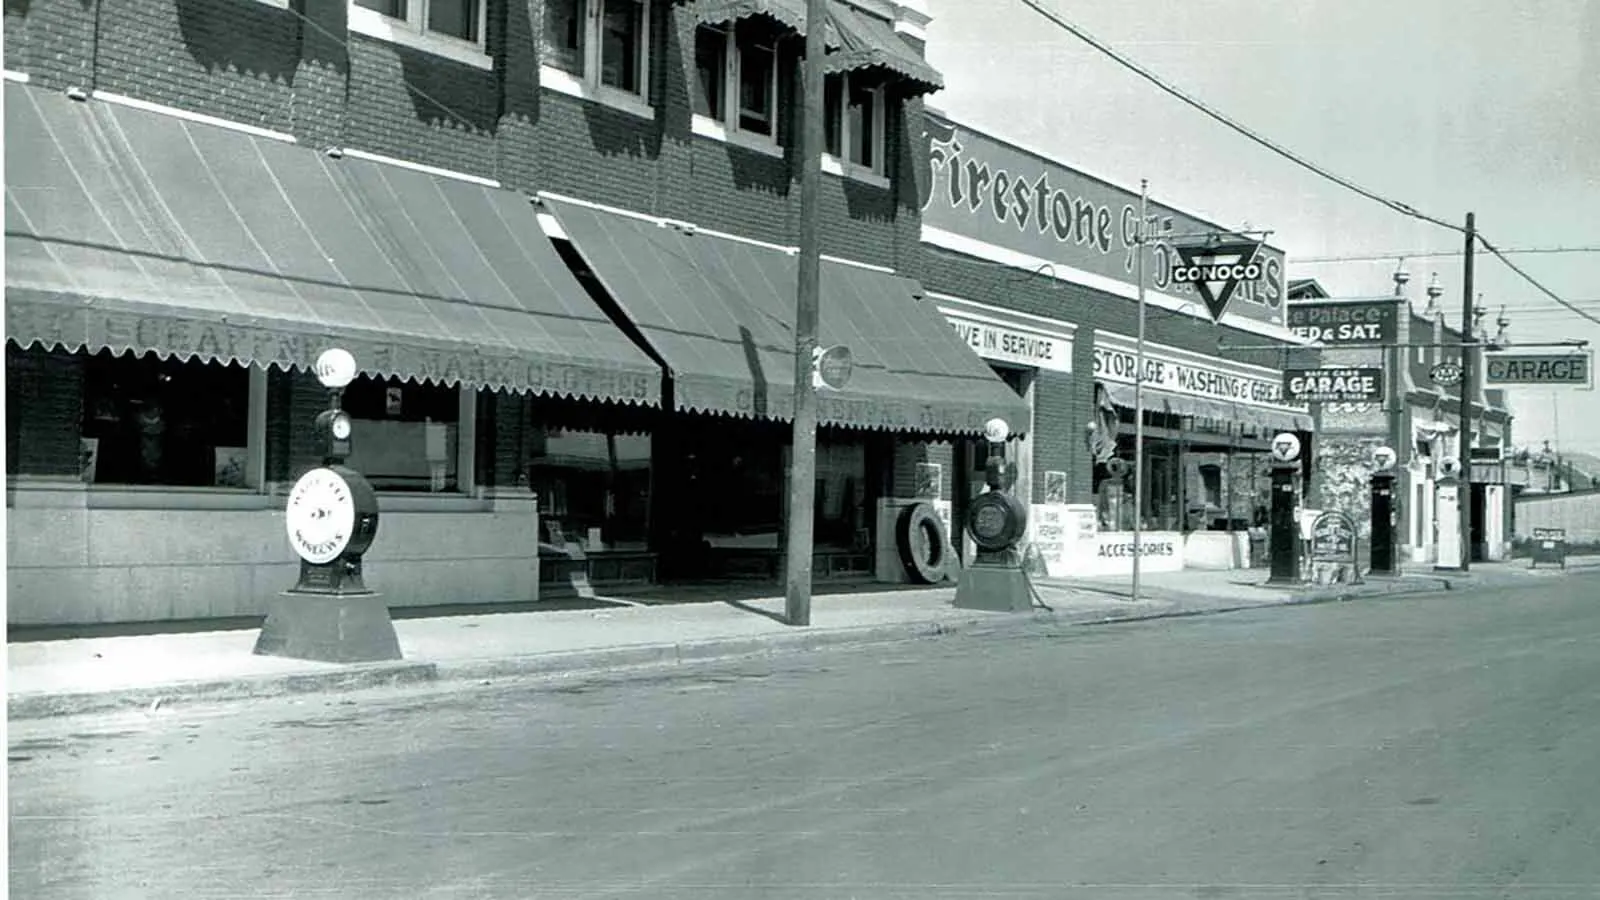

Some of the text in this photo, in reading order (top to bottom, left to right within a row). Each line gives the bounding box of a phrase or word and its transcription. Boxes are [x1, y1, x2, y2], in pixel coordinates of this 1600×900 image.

[921, 126, 1112, 255] Firestone
[1173, 264, 1260, 282] CONOCO
[1309, 307, 1381, 324] Palace
[1322, 328, 1335, 341] &
[1338, 323, 1382, 340] SAT.
[984, 329, 997, 349] IN
[1002, 333, 1053, 360] SERVICE
[1487, 360, 1585, 380] GARAGE
[1176, 366, 1242, 399] WASHING
[1290, 375, 1376, 394] GARAGE
